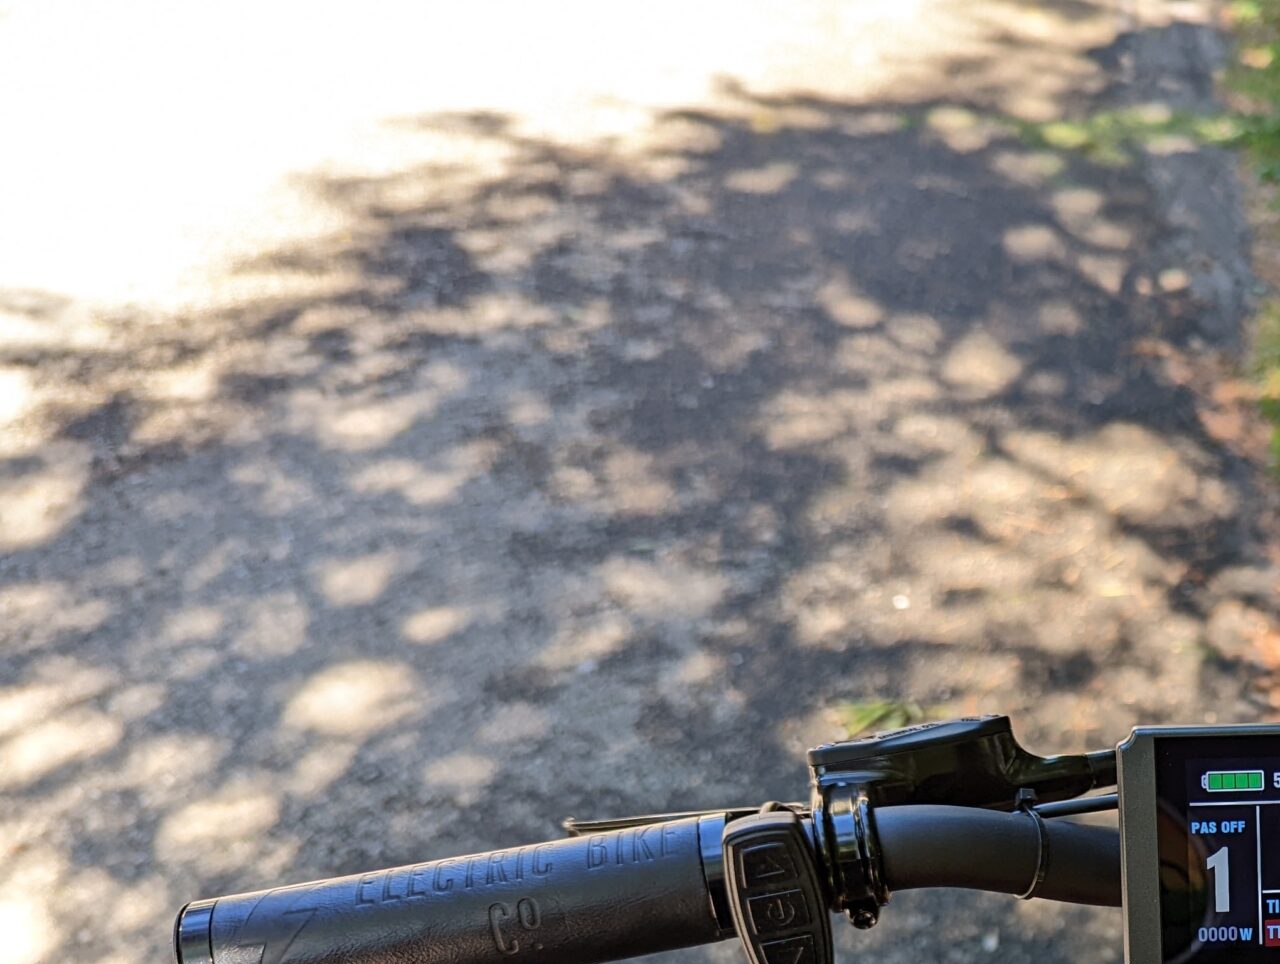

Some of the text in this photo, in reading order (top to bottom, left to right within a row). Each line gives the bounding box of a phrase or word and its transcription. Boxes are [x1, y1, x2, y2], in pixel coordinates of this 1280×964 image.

[1191, 820, 1246, 834] PAS OFF
[354, 824, 677, 907] ELECTRIC BIKE
[1206, 846, 1230, 913] 1
